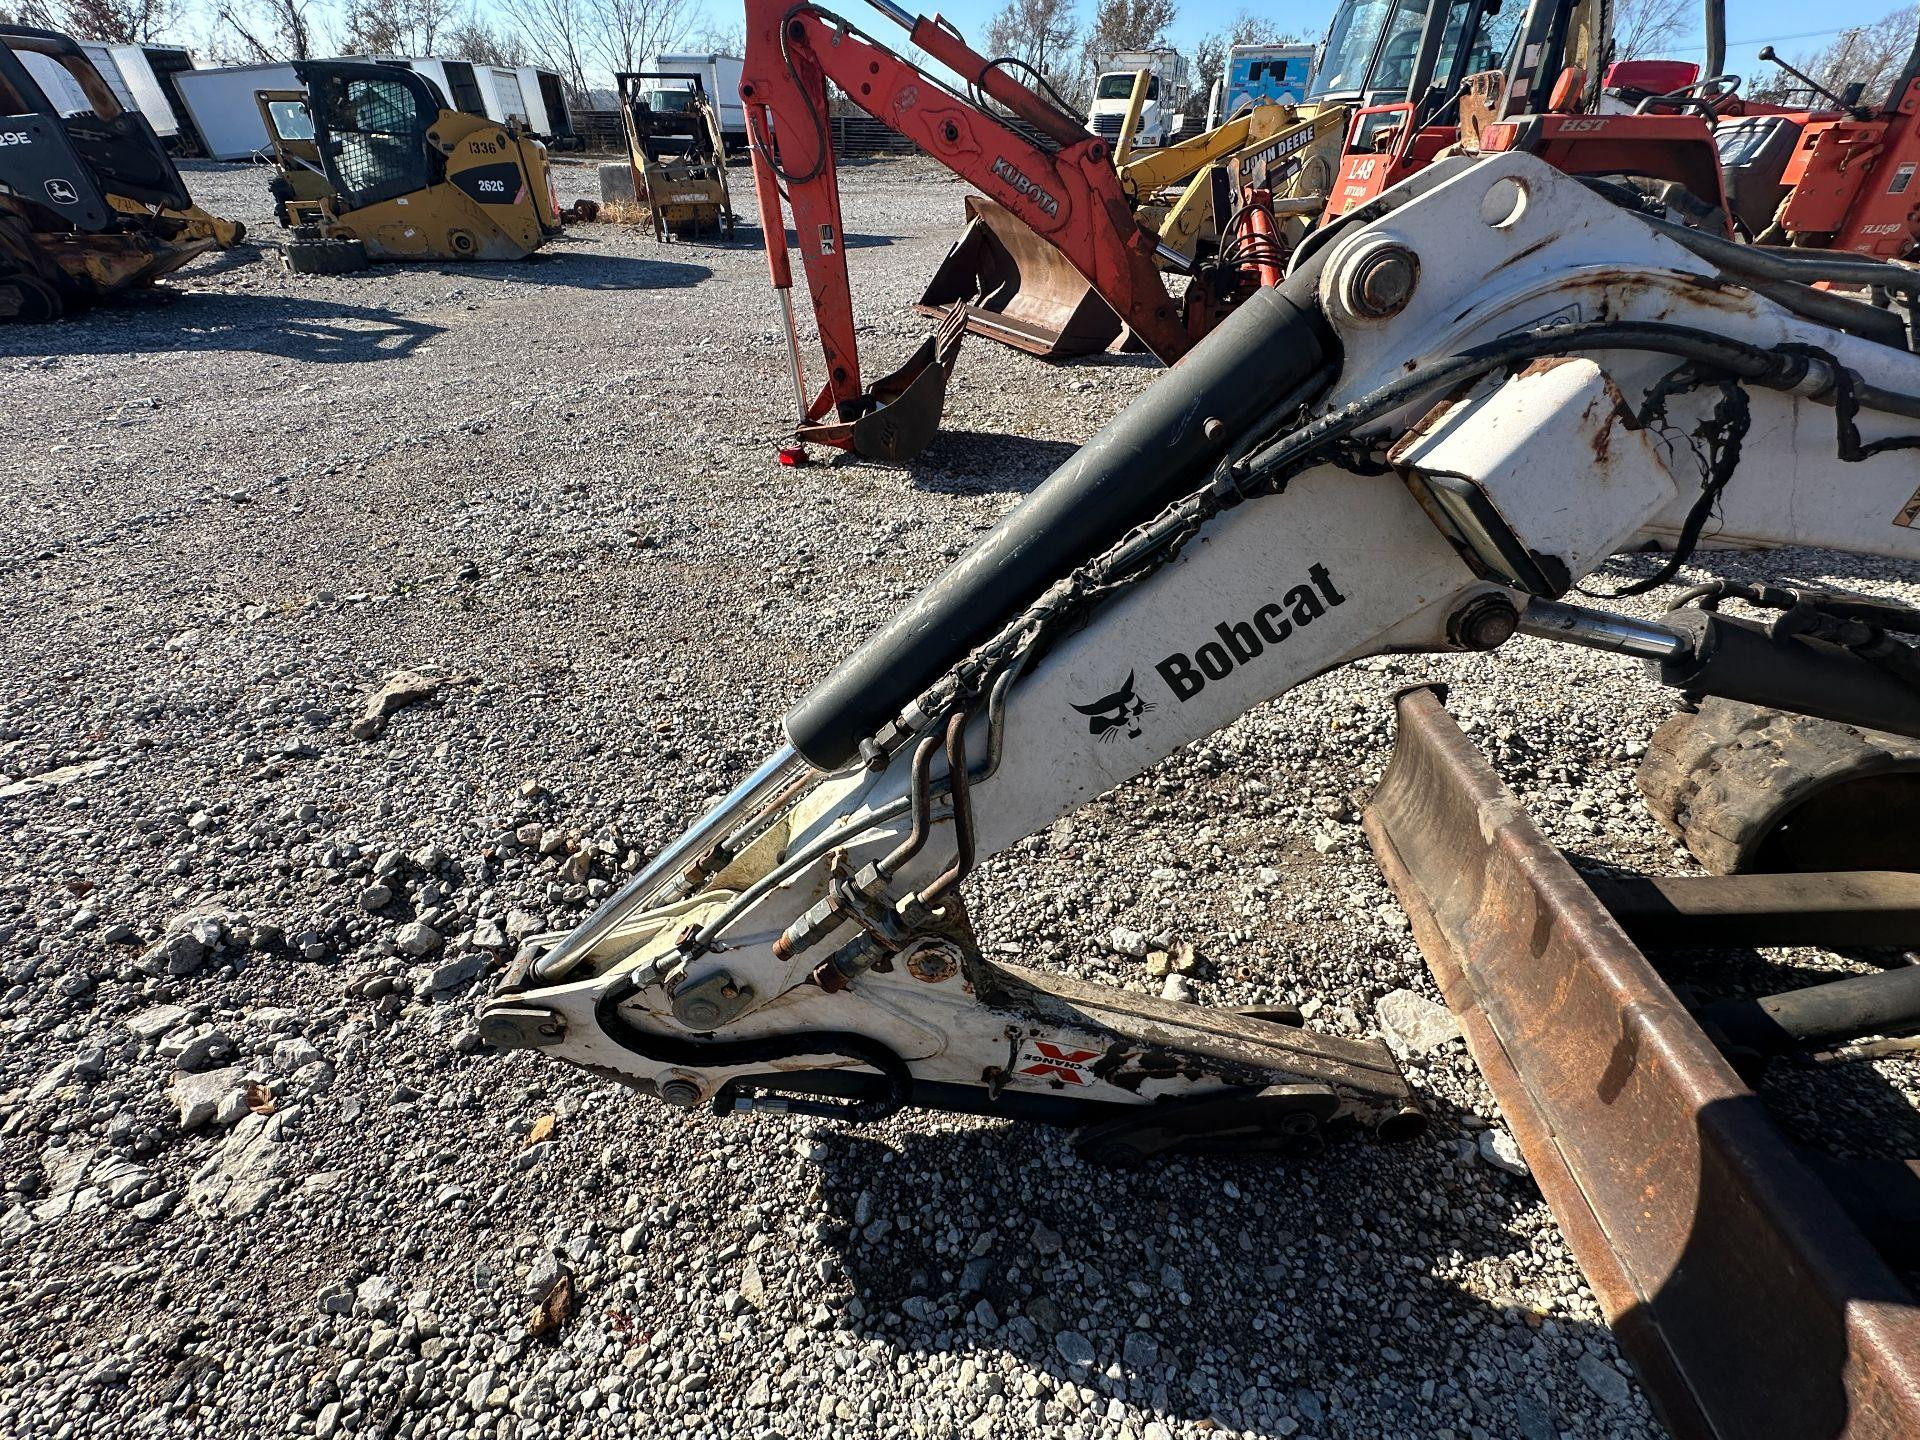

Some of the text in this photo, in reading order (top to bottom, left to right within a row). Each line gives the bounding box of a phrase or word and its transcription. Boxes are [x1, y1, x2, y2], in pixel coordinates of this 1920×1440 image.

[1558, 119, 1610, 132] HST
[468, 141, 497, 154] 1336
[1278, 125, 1314, 157] DEERE
[1347, 159, 1376, 180] L48
[478, 180, 505, 192] 262C
[992, 155, 1059, 219] KUBOTA
[1155, 562, 1347, 703] Bobcat
